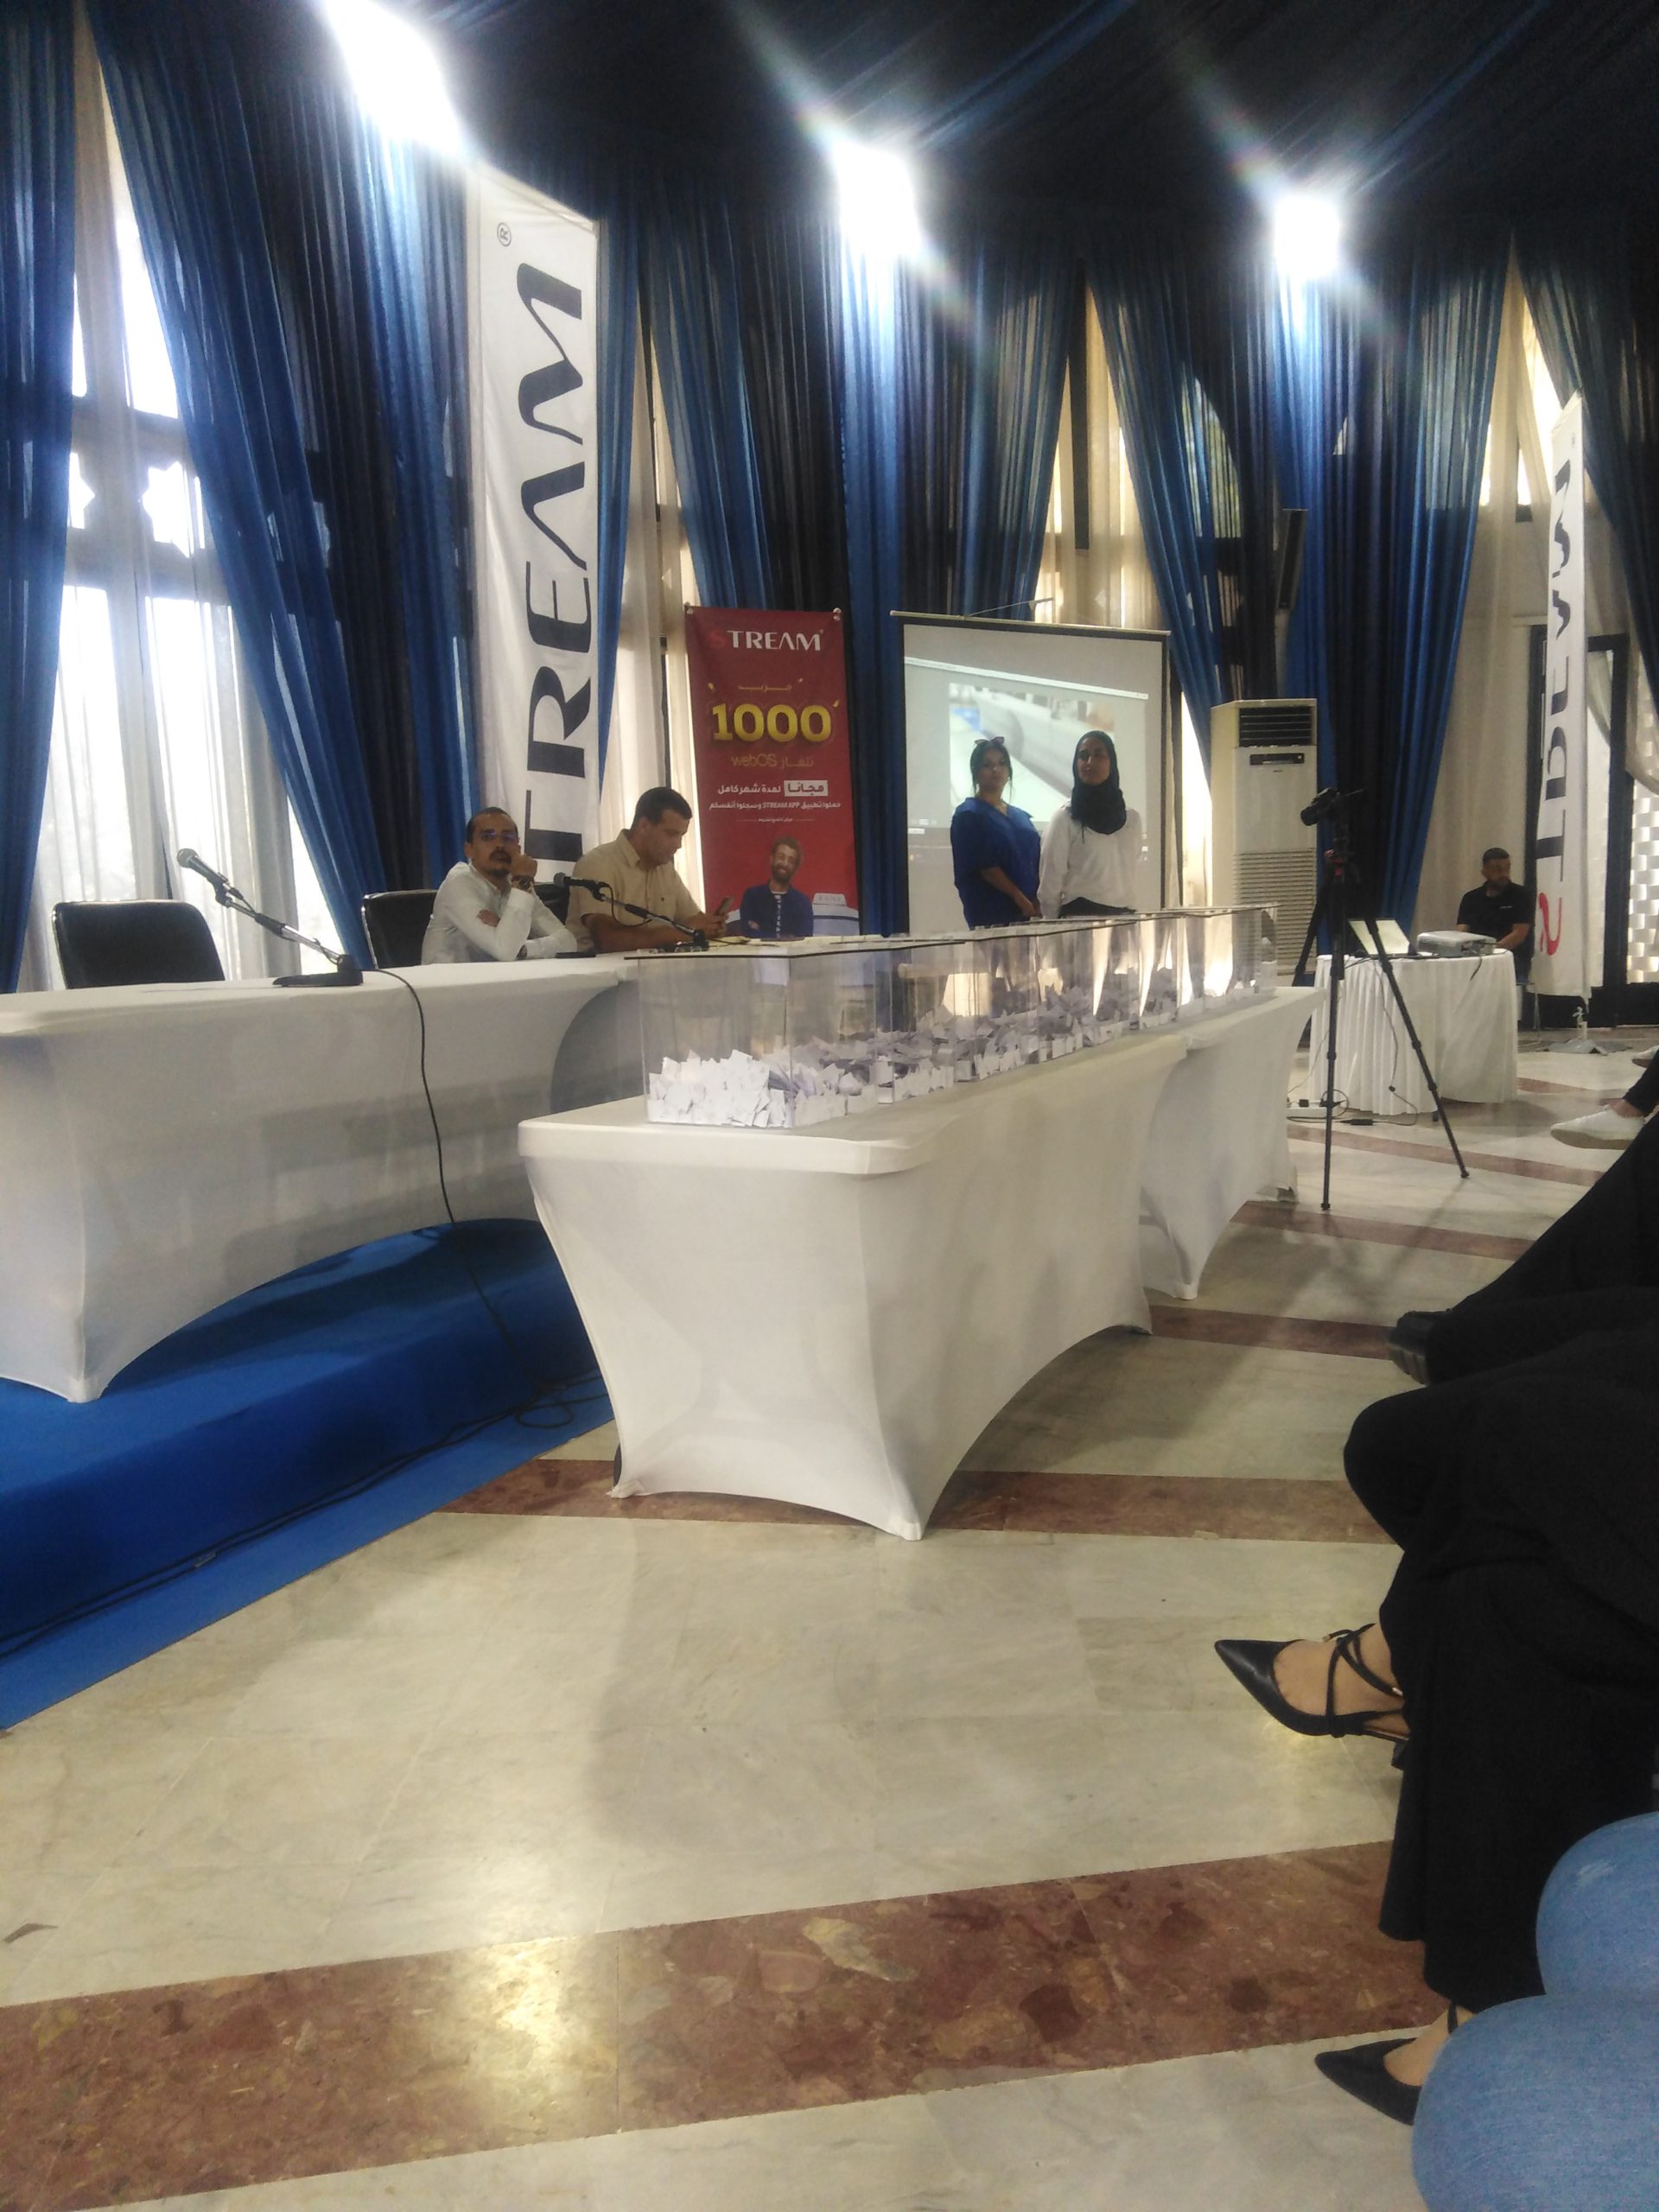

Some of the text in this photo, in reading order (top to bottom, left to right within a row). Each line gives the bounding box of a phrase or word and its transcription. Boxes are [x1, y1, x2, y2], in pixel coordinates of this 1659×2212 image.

[517, 263, 592, 862] TREAM
[709, 630, 821, 651] STREAM
[712, 703, 831, 741] 1000
[731, 753, 777, 767] webOS
[718, 785, 740, 794] كامل
